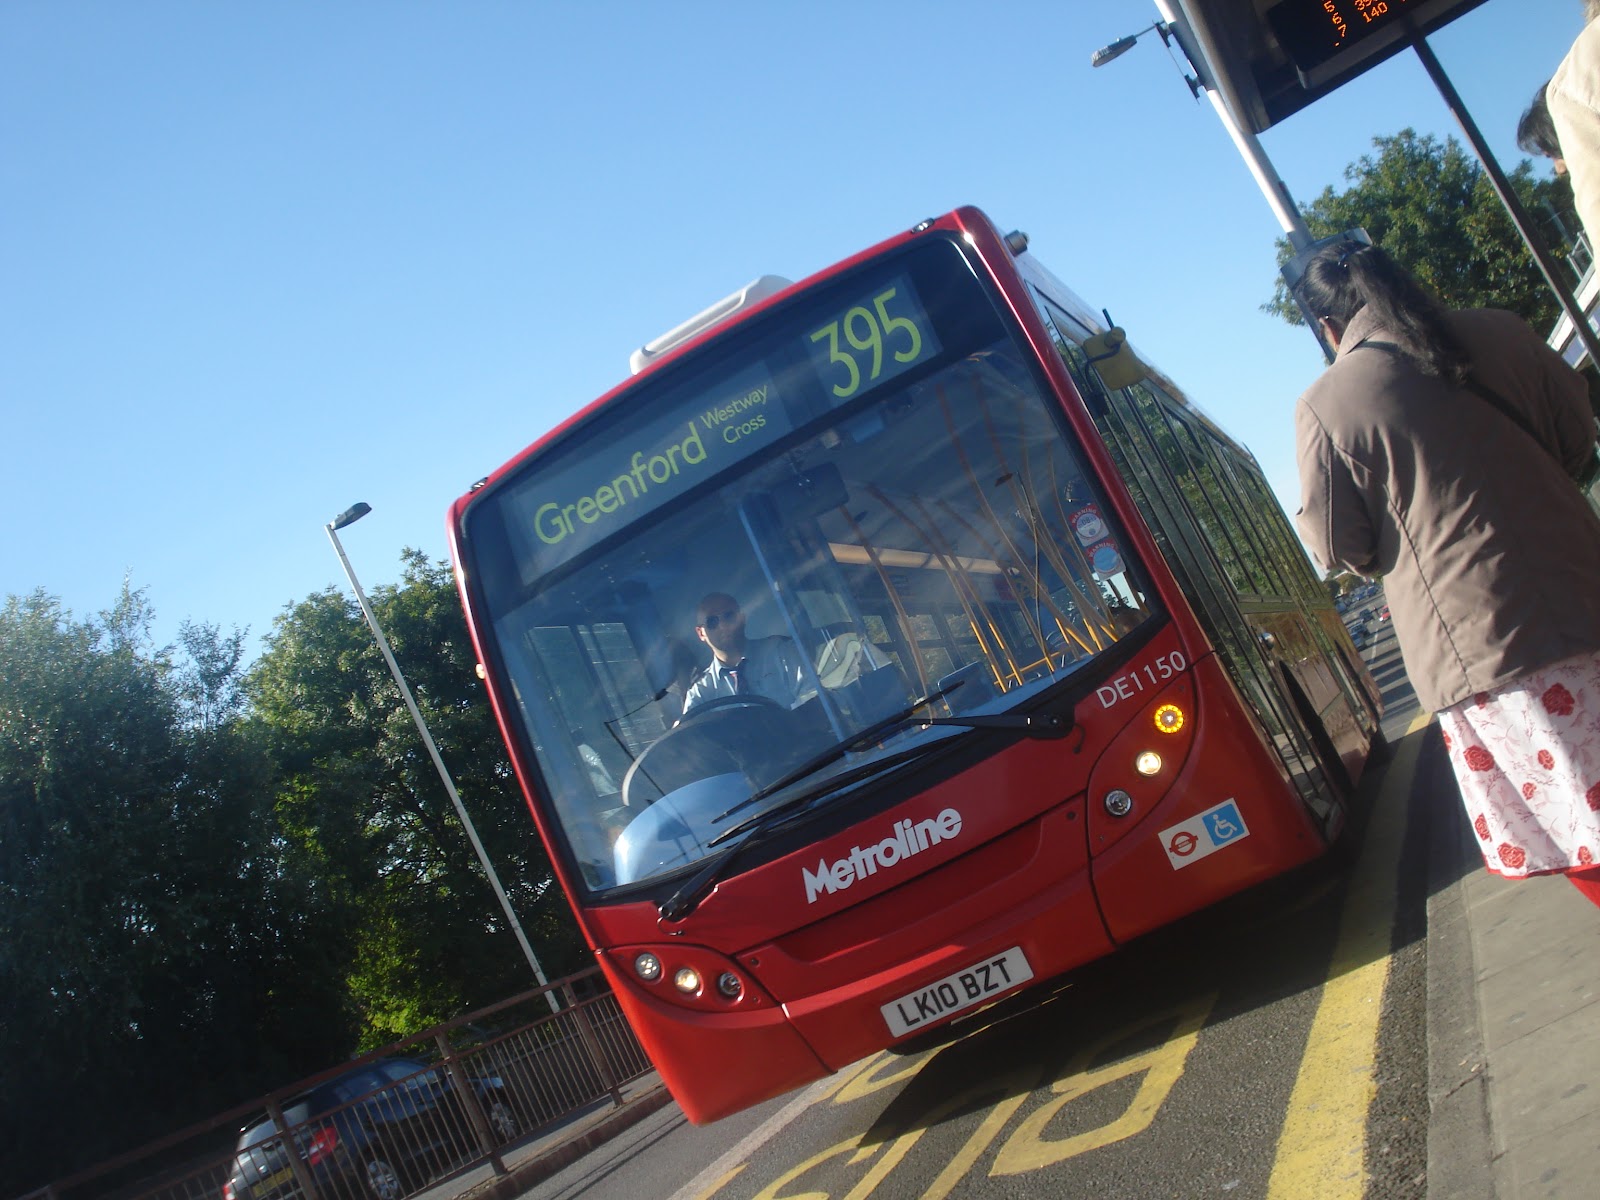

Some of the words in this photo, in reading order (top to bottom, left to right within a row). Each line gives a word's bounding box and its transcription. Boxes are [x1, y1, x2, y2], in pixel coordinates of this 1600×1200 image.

[1323, 0, 1335, 12] 5
[1332, 12, 1342, 24] 6
[1338, 24, 1347, 37] 7
[1362, 2, 1388, 23] 140
[810, 287, 922, 398] 395
[700, 385, 768, 429] Westway
[723, 415, 766, 443] Cross
[534, 421, 708, 545] Greenford
[1095, 650, 1187, 709] DE1150
[801, 808, 963, 904] Metroline
[897, 983, 959, 1027] LK10
[958, 957, 1012, 1000] BZT
